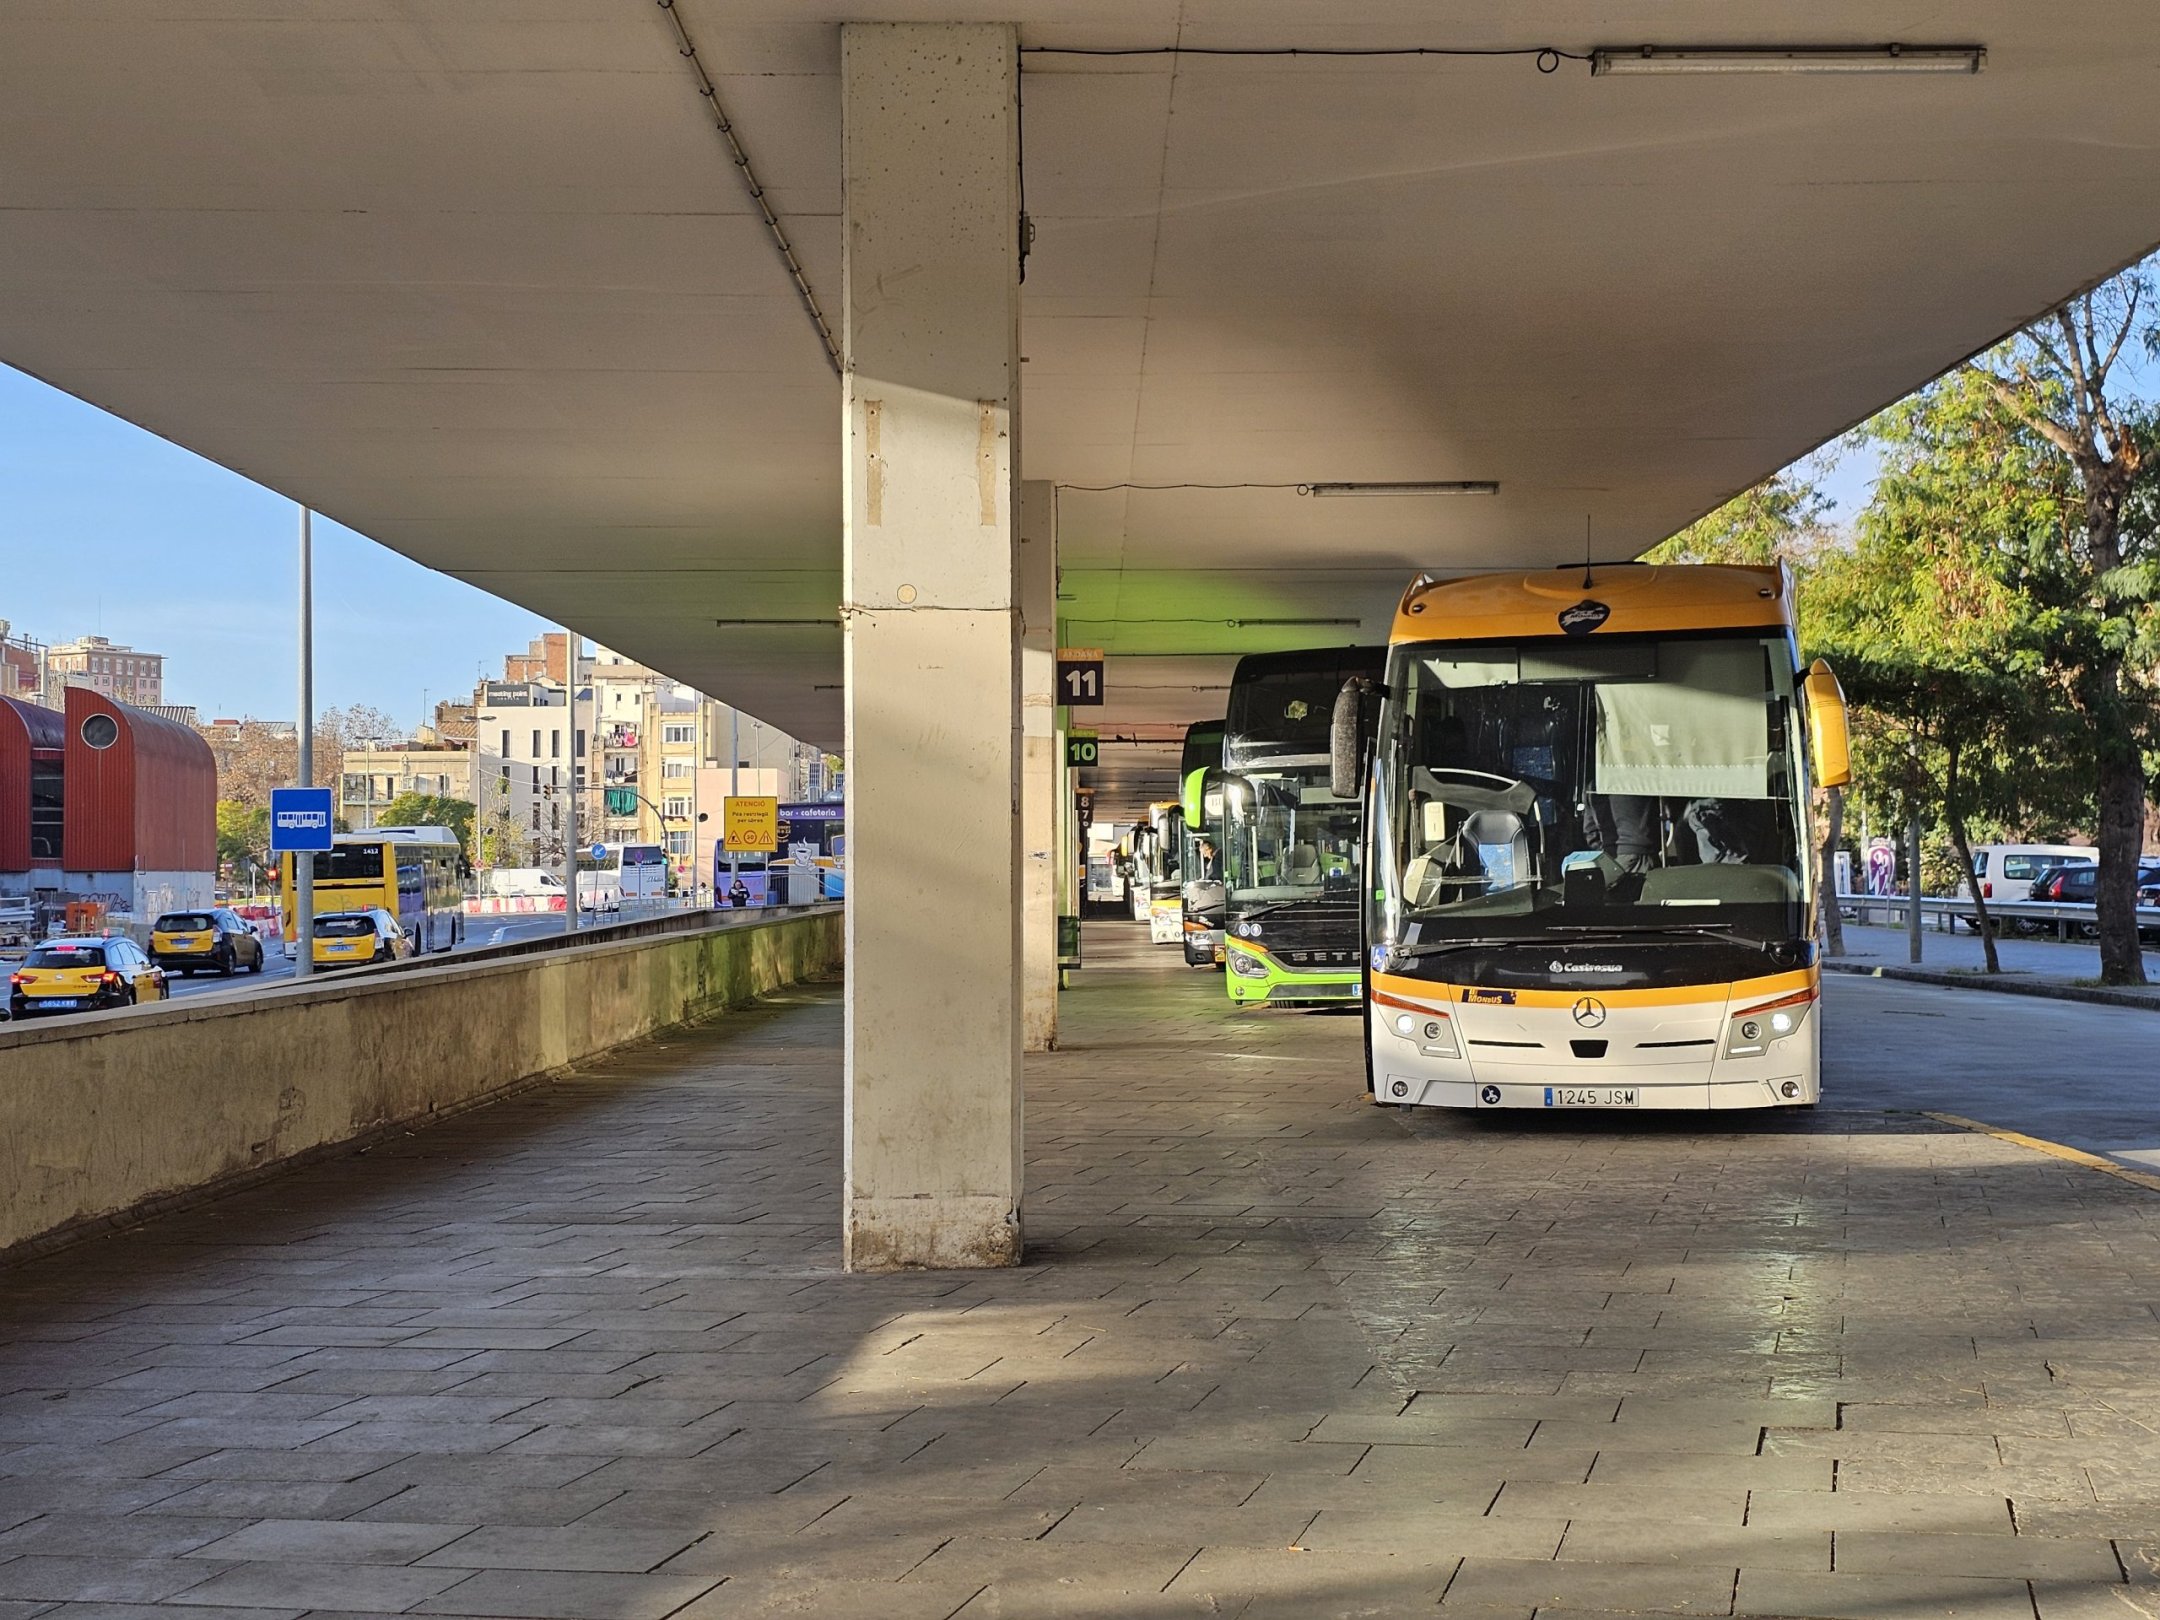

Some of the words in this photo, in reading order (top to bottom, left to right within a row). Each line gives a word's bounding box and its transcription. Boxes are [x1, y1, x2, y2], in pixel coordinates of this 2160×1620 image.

[1066, 669, 1096, 697] 11
[1070, 743, 1096, 761] 10
[1081, 796, 1089, 807] 8
[801, 808, 836, 816] cafeteria
[1082, 810, 1089, 819] 7
[1564, 963, 1623, 972] Castrosua
[1558, 1090, 1597, 1104] 1245
[1604, 1090, 1634, 1104] JSM
